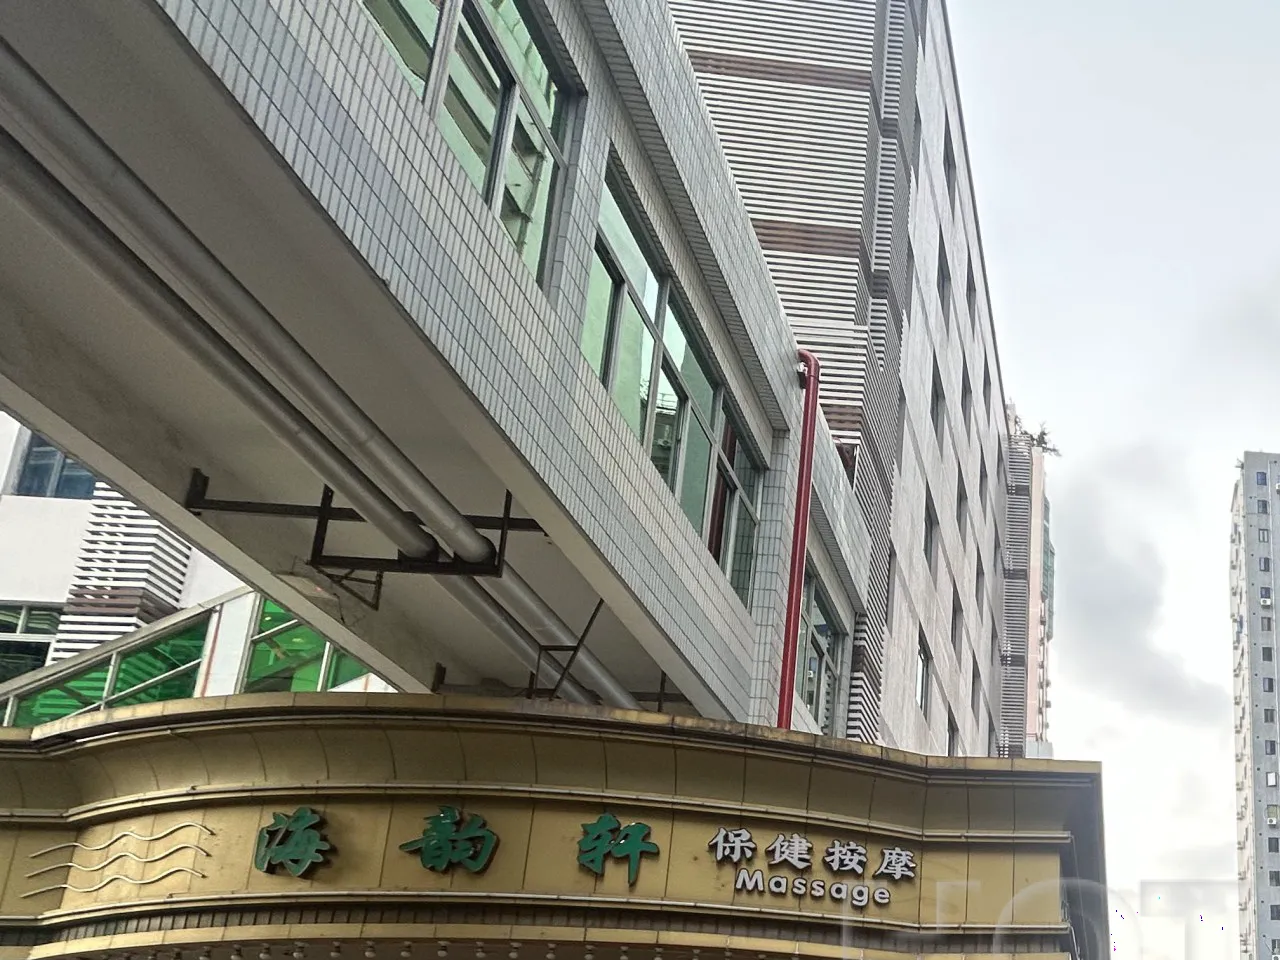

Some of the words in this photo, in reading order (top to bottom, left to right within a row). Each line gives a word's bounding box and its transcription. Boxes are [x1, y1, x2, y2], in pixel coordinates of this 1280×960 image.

[254, 805, 660, 887] 海韵轩
[708, 827, 917, 880] 保健按摩
[735, 868, 891, 906] Massage
